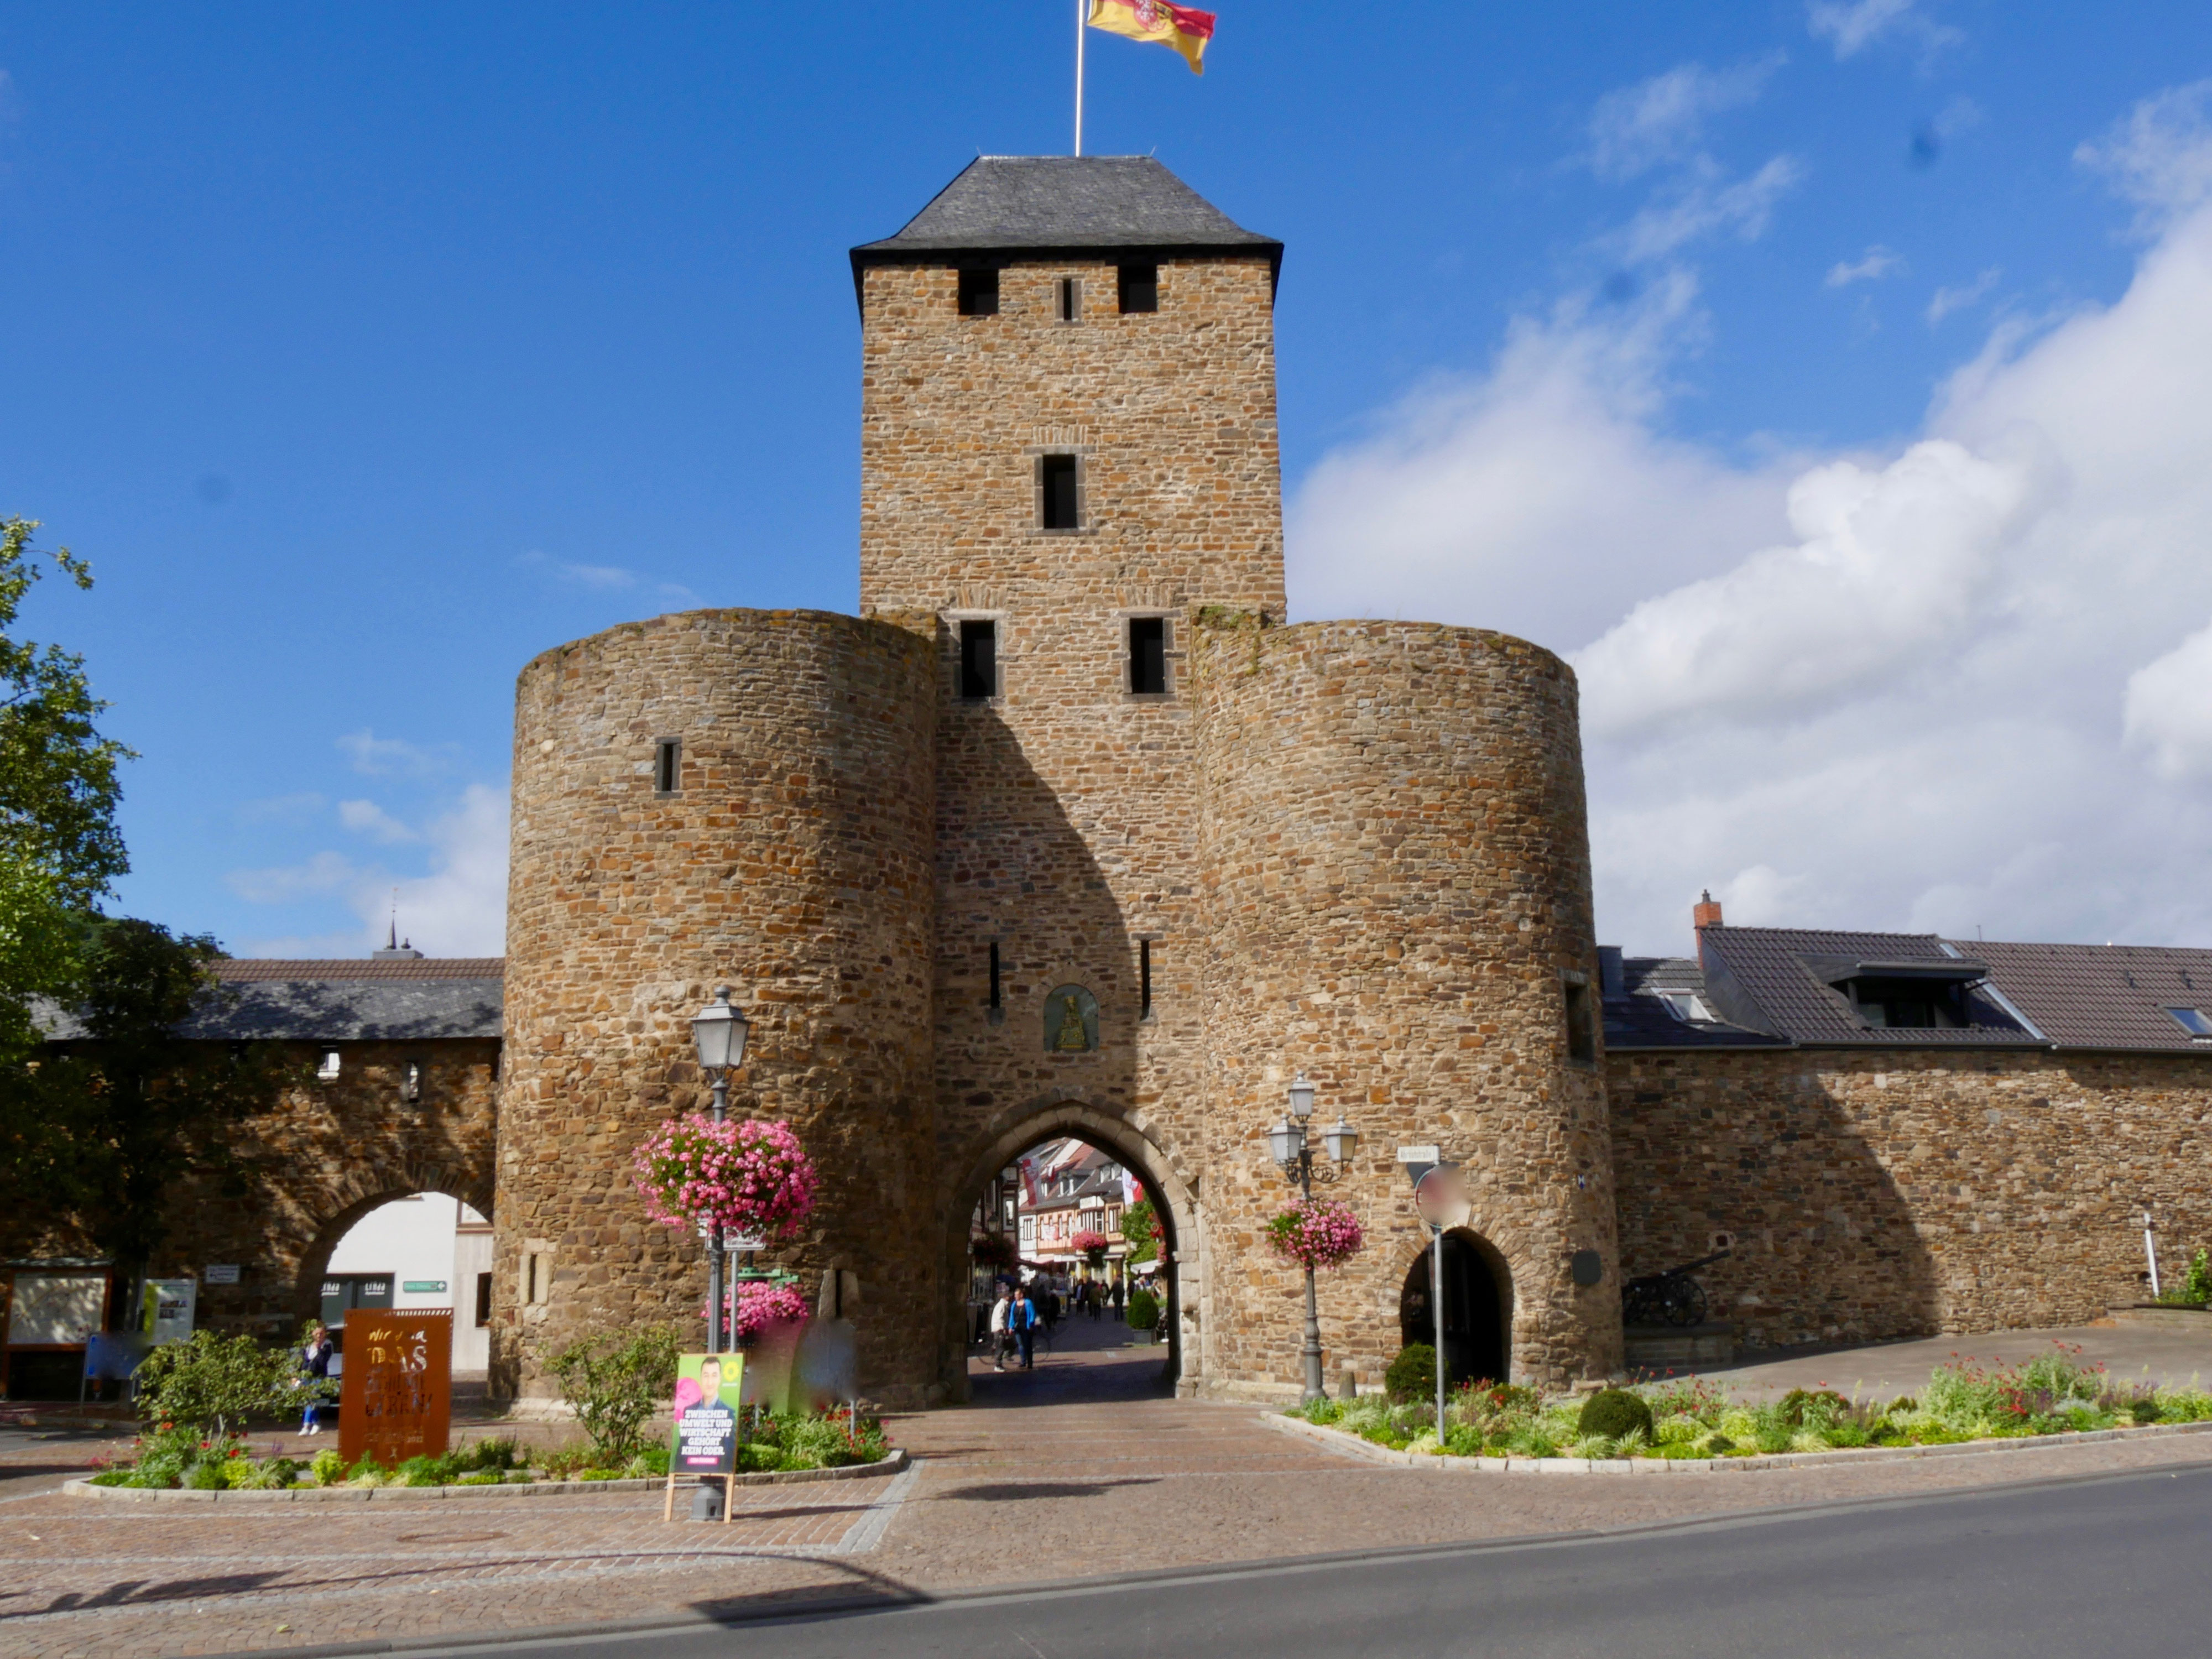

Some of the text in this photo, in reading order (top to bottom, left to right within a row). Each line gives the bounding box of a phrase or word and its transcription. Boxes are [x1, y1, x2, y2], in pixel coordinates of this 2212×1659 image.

[685, 1409, 728, 1418] ZWISCHEN
[679, 1418, 733, 1428] UMWELT UND
[679, 1428, 732, 1437] WIRTSCHAFT
[681, 1446, 702, 1455] KEIN
